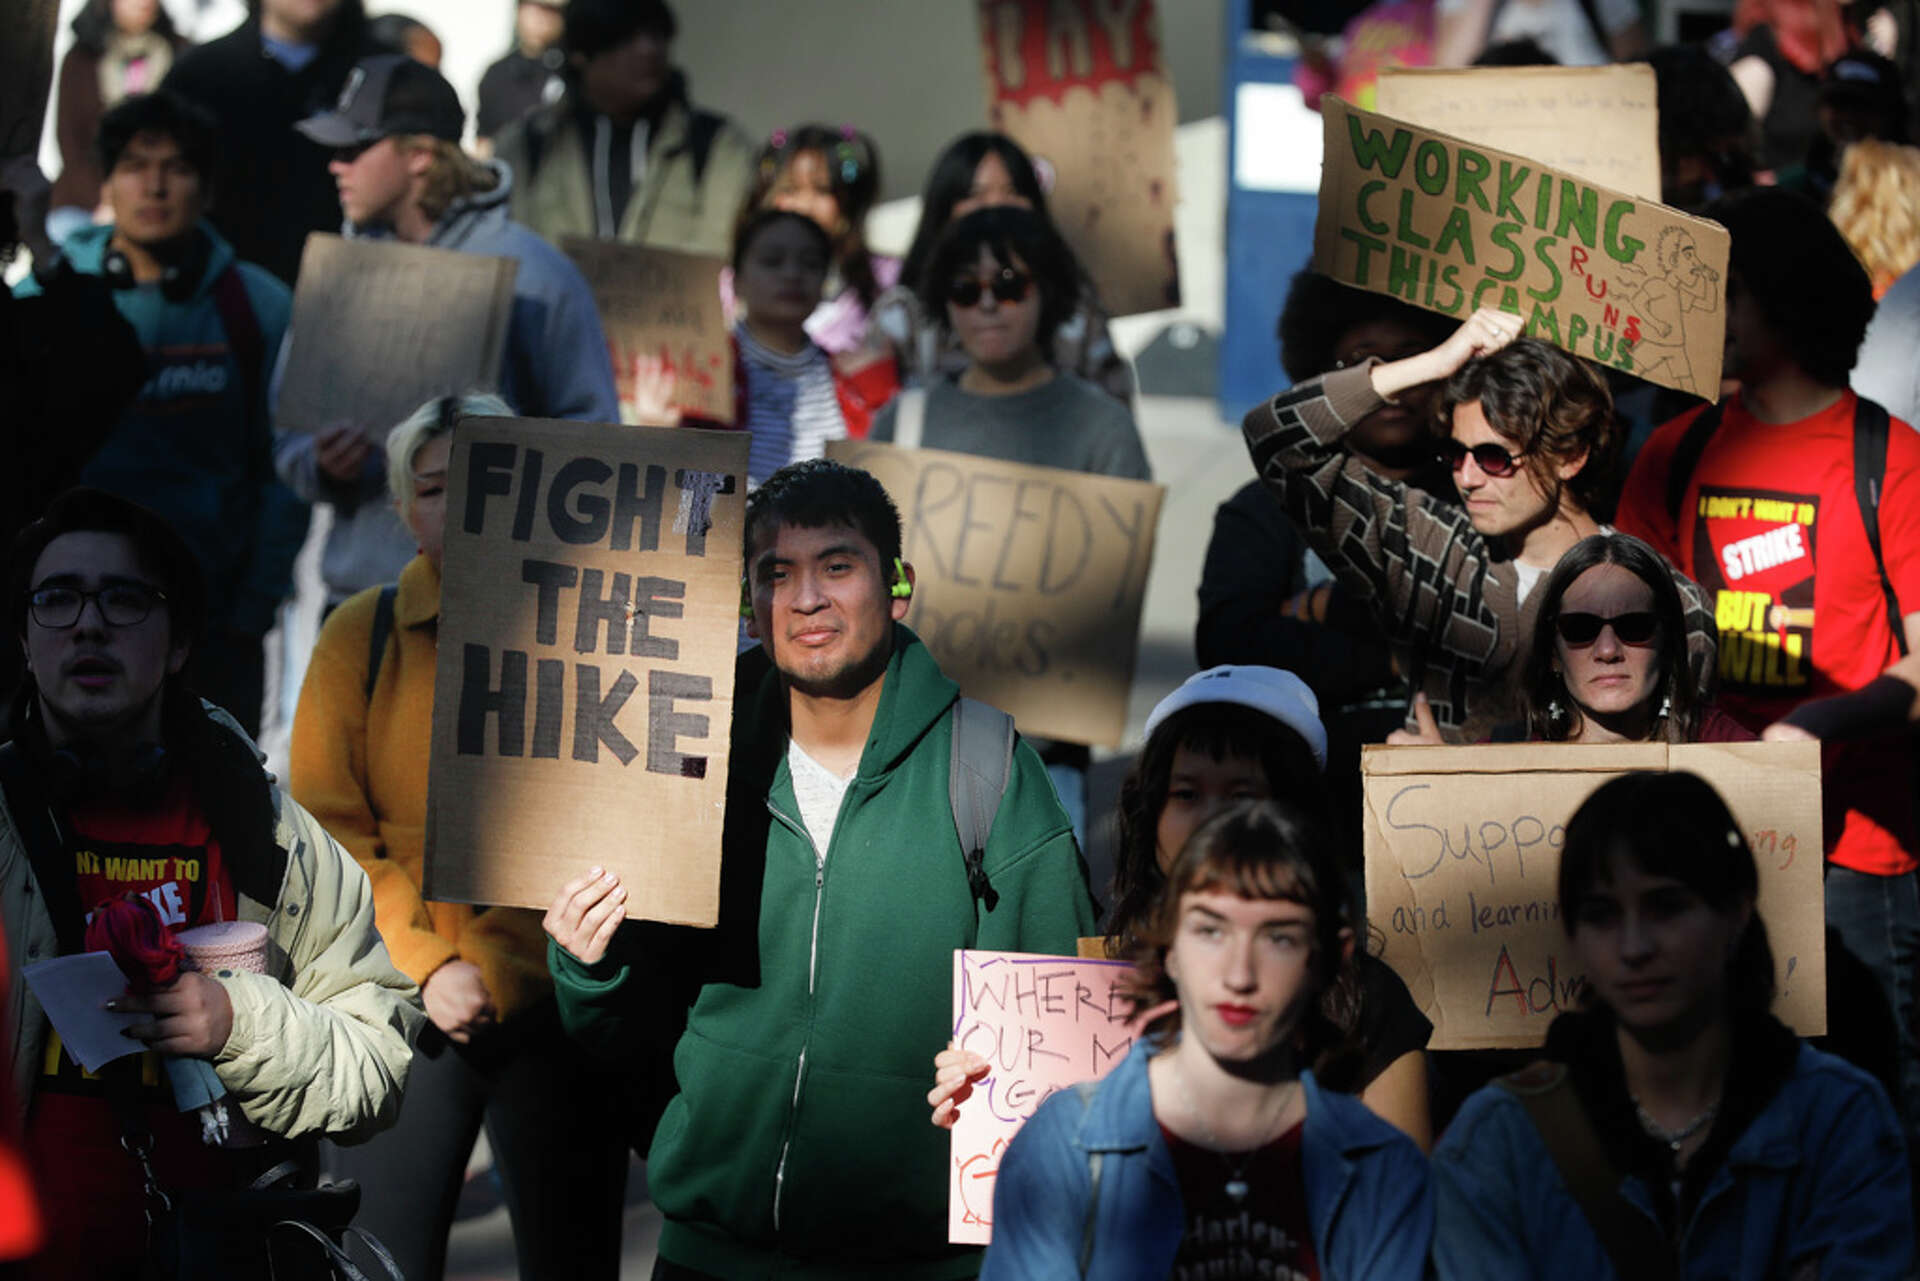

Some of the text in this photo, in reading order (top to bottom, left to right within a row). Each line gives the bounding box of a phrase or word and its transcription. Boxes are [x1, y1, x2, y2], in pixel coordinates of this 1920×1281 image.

[1347, 113, 1646, 264] WORKING
[1357, 180, 1563, 302] CLASS
[1341, 227, 1634, 372] THIS CAMPUS
[1570, 245, 1641, 347] RUNS
[463, 442, 736, 557] FIGHT
[1722, 522, 1806, 580] STRIKE
[521, 559, 687, 661] THE
[1715, 590, 1772, 632] BUT
[457, 643, 714, 780] HIKE
[104, 857, 169, 882] WANT
[173, 857, 200, 883] TO
[1392, 896, 1452, 935] and
